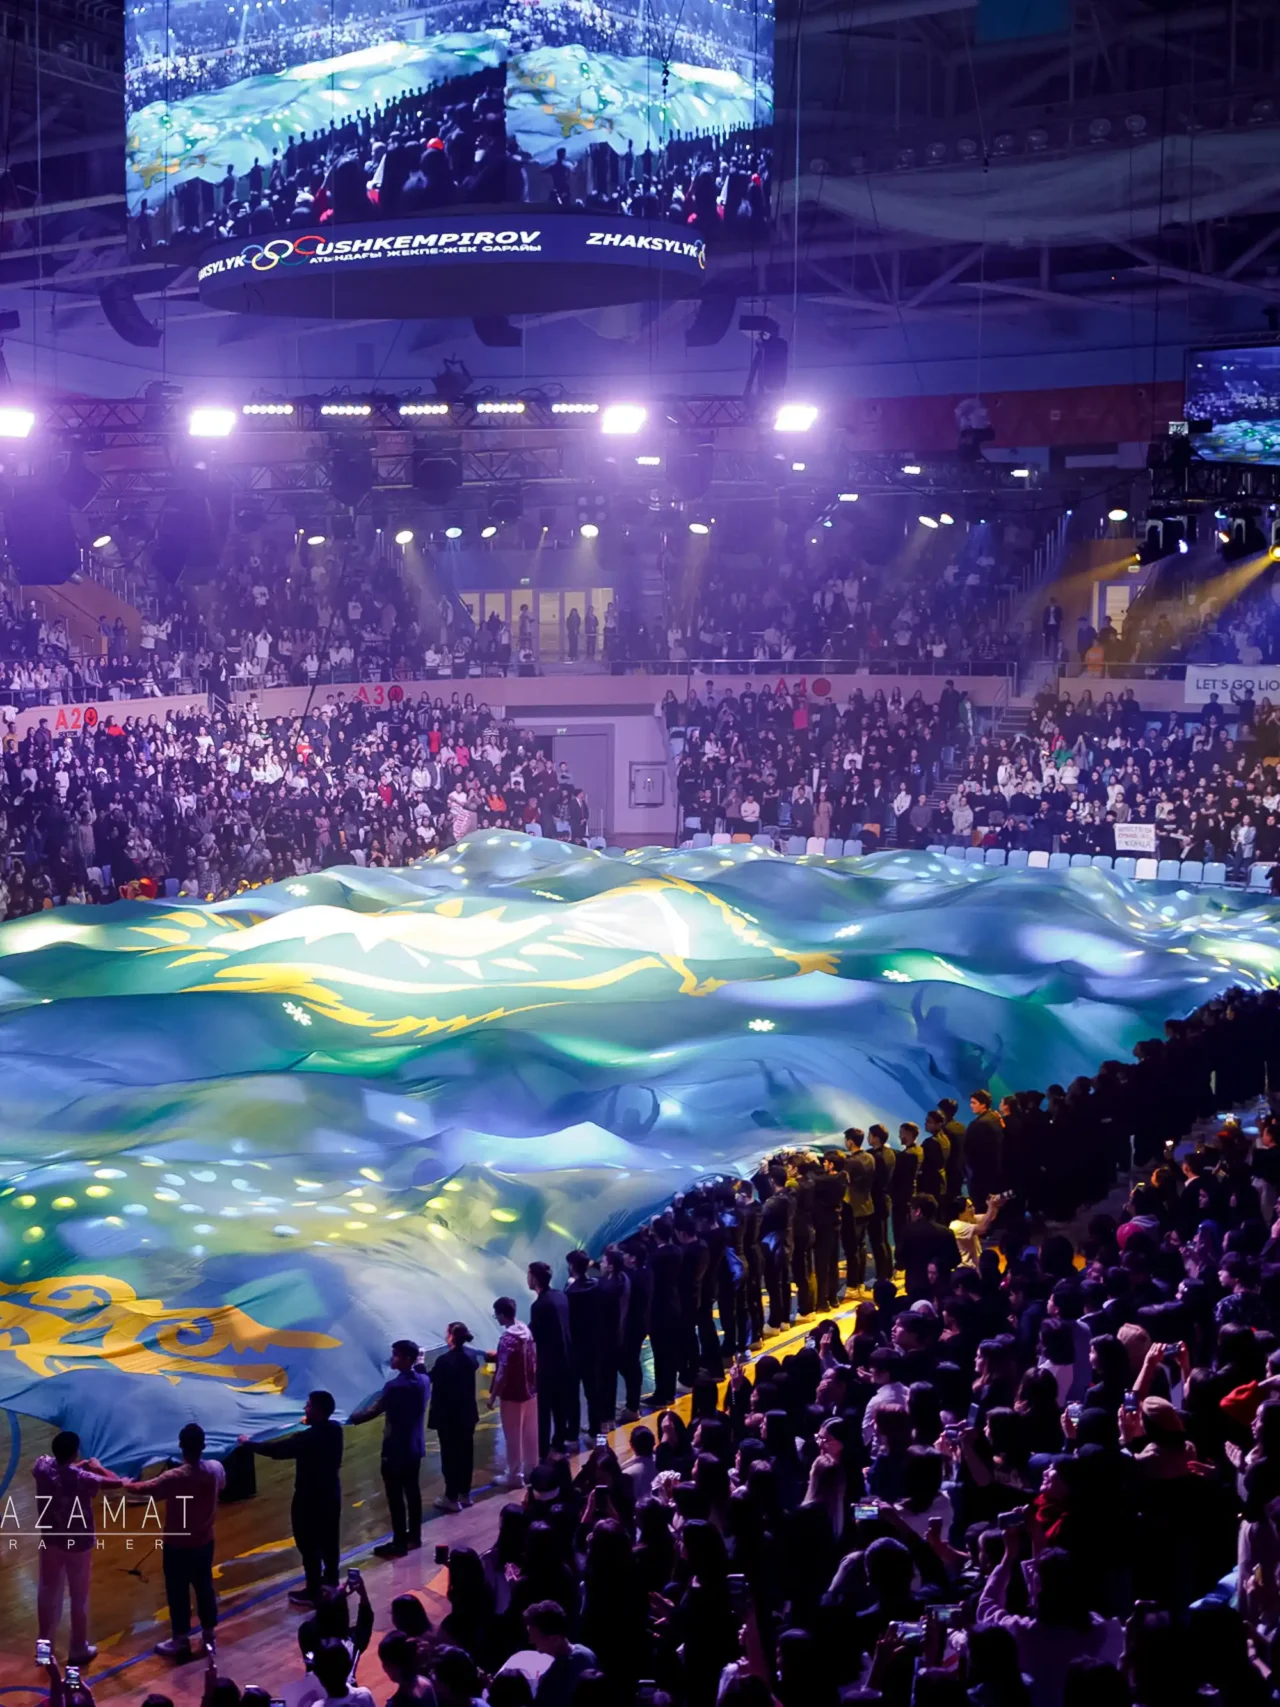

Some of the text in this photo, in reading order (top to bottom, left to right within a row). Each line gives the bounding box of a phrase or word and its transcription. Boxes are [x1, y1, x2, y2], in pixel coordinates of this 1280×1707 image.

[315, 230, 541, 256] USHKEMPIROV
[386, 246, 478, 257] ЖЕКПЕ-ЖЕК
[482, 243, 542, 253] САРАЙЫ
[585, 232, 698, 258] ZHAKSYLYK
[1196, 678, 1228, 690] LET'S
